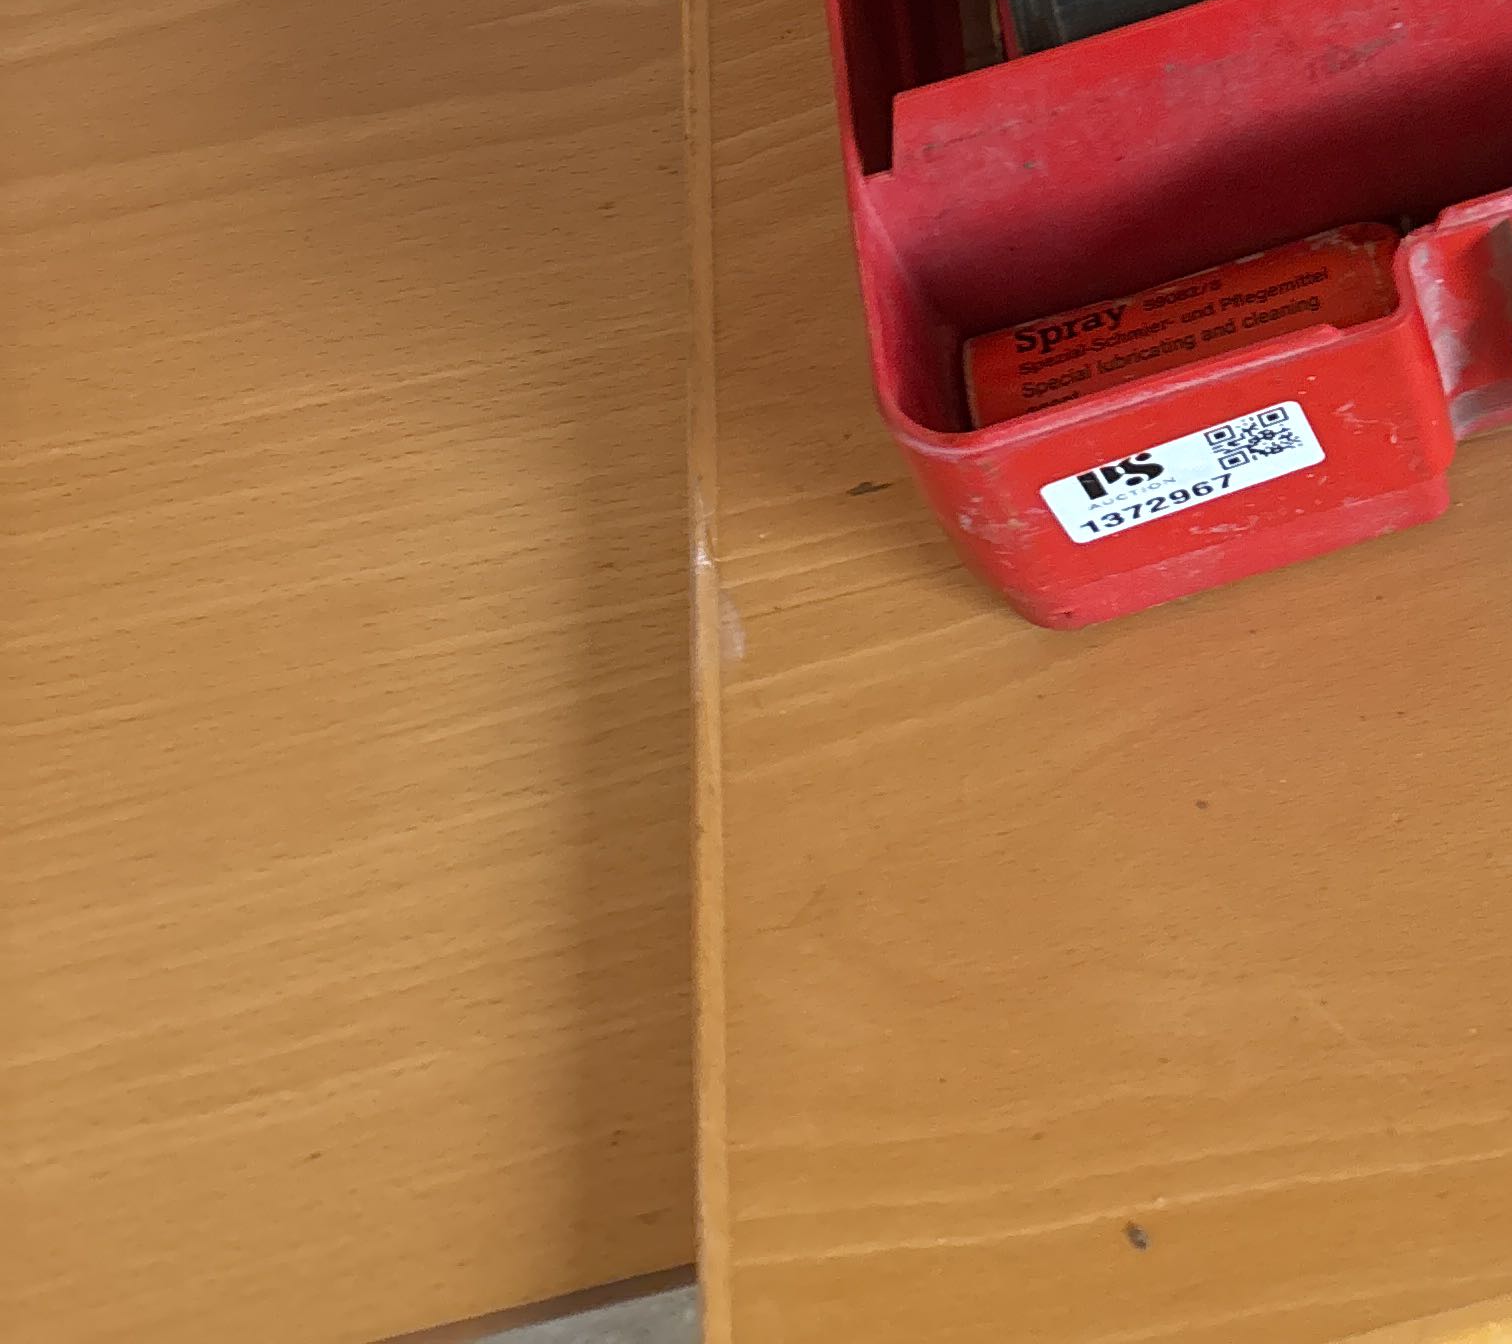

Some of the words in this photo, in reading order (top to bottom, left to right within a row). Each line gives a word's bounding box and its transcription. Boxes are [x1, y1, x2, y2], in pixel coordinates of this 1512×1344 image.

[1014, 304, 1128, 354] Spray
[1203, 320, 1237, 346] and
[1080, 473, 1234, 534] 1372967
[1087, 476, 1176, 510] AUCTION
